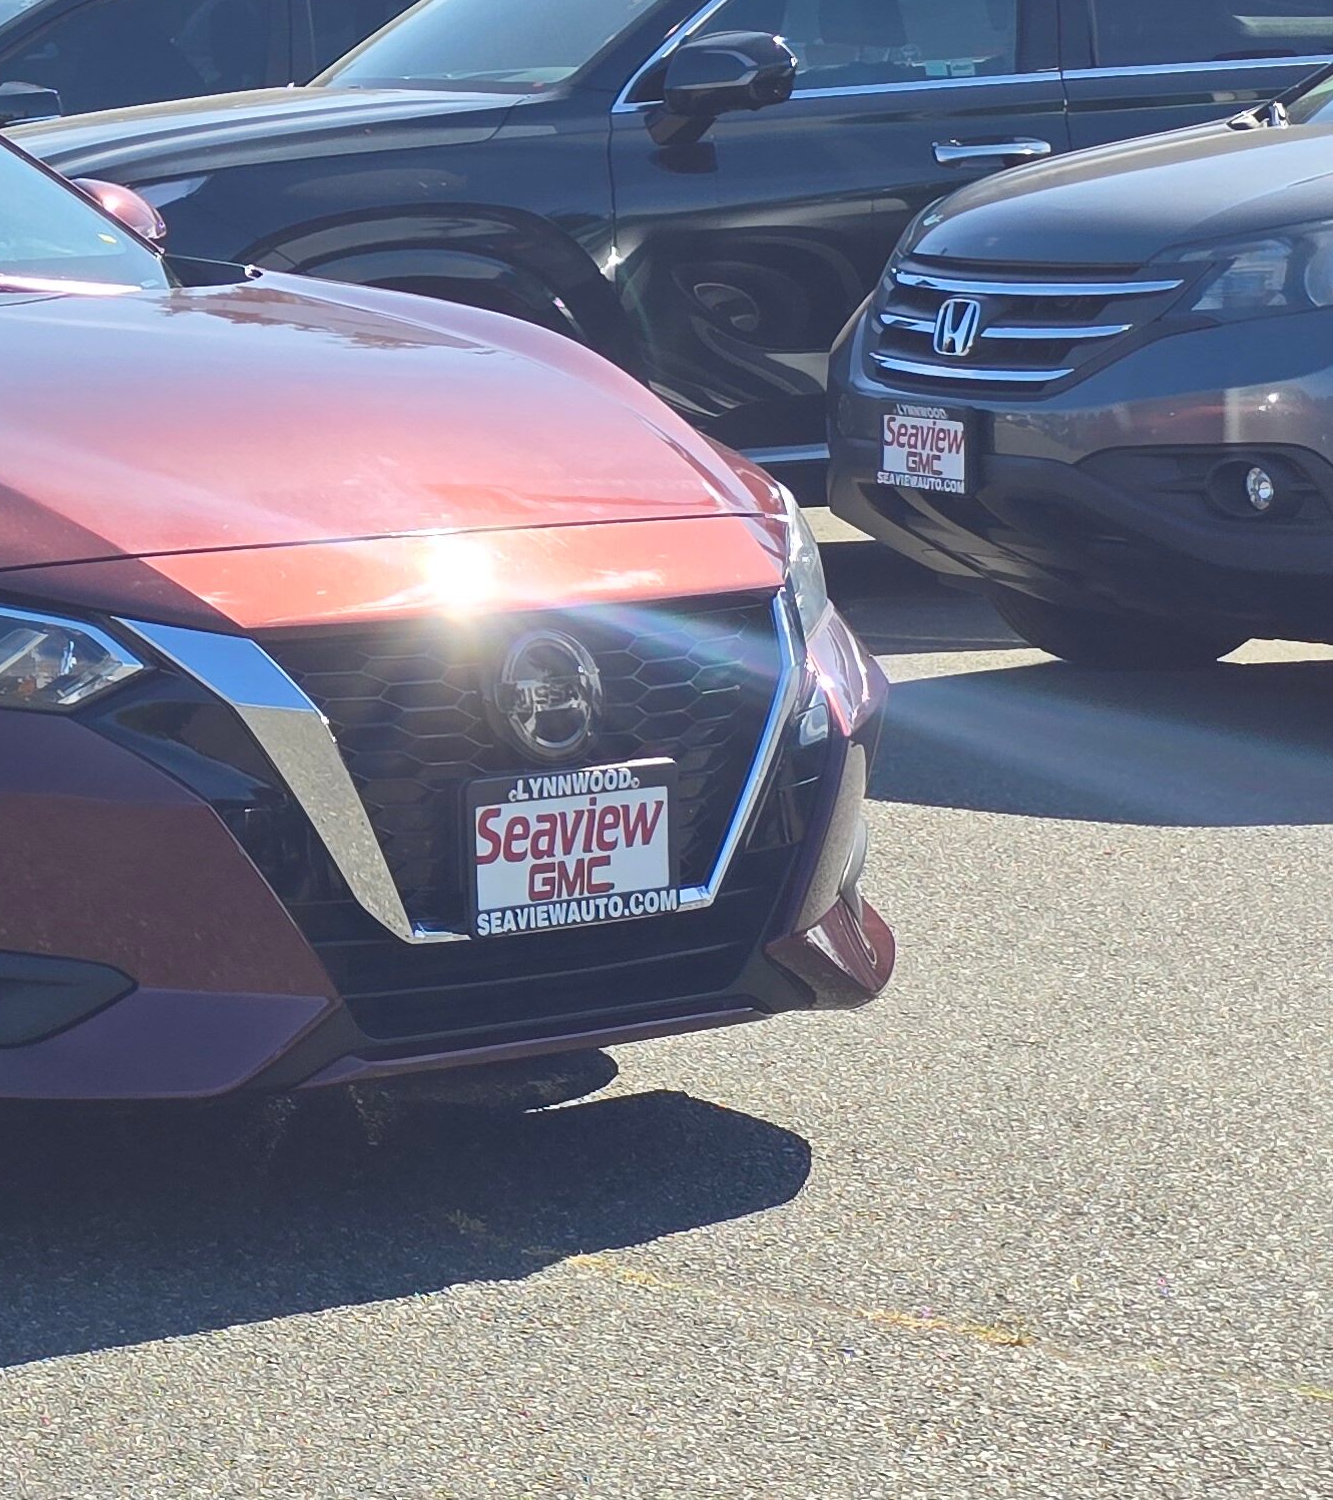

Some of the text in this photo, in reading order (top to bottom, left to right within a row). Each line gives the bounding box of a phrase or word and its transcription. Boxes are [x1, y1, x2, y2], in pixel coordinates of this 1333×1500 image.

[883, 416, 964, 455] Seaview
[876, 471, 965, 494] SEAVIEWAUTO.COM
[906, 450, 943, 476] GMC
[517, 768, 632, 801] LYNNWOOD
[476, 796, 665, 866] Seaview
[528, 854, 615, 902] GMC
[477, 888, 678, 937] SEAVIEWAUTO.COM
